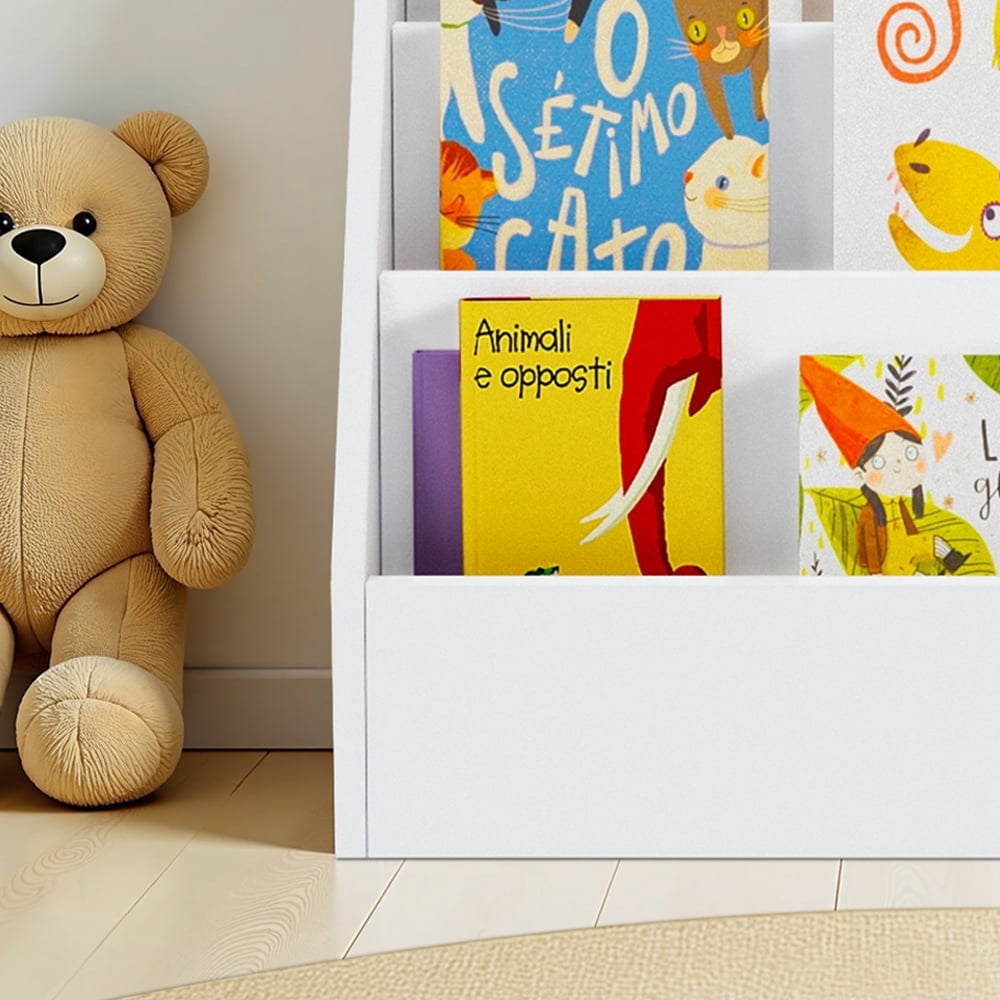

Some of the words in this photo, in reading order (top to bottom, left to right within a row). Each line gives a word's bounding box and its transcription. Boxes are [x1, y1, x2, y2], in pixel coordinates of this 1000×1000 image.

[473, 318, 573, 356] Animali
[473, 366, 493, 389] e
[500, 356, 613, 399] opposti
